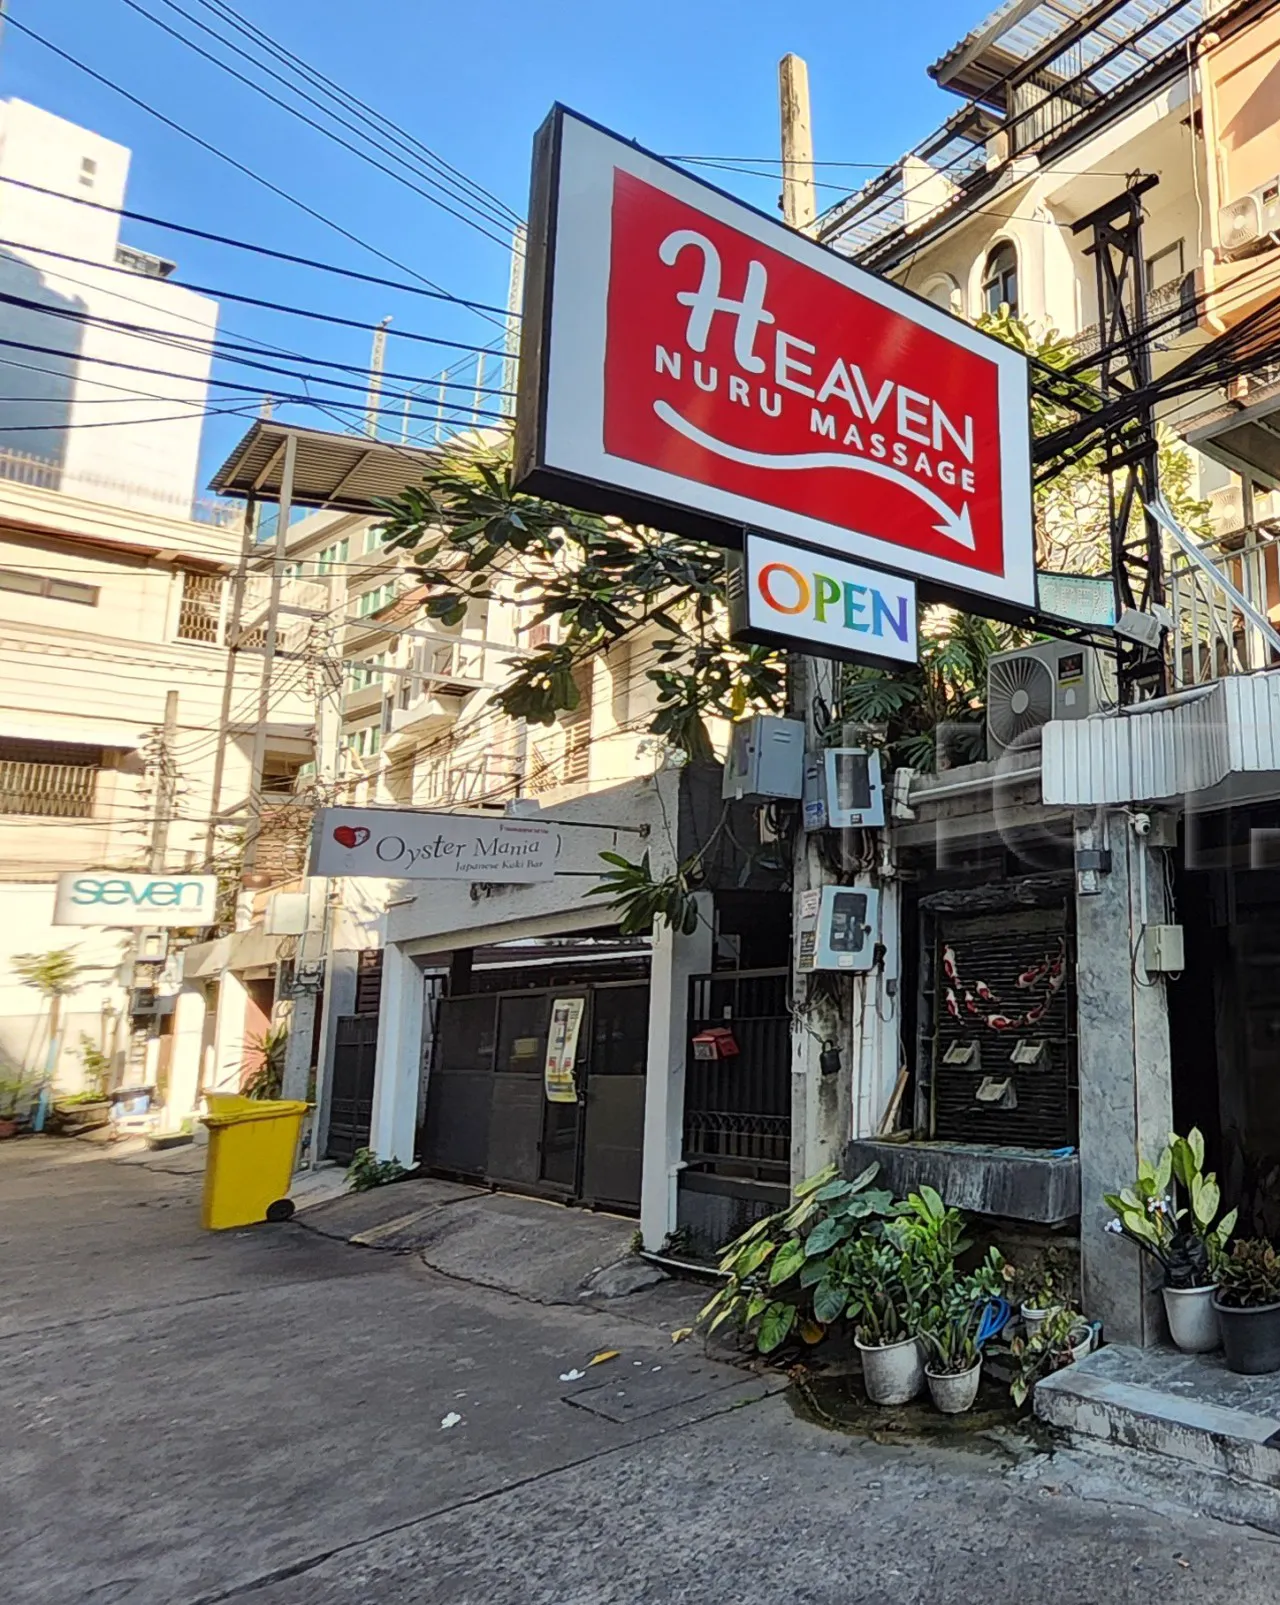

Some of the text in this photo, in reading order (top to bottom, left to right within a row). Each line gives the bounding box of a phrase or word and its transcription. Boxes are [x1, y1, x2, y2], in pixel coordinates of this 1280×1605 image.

[658, 229, 974, 464] HEAVEN
[655, 344, 976, 494] NURU MASSAGE
[758, 561, 910, 643] OPEN
[375, 833, 540, 870] Oyster Mania
[456, 861, 499, 872] Japanese
[527, 860, 543, 869] Bar
[70, 879, 205, 907] seven
